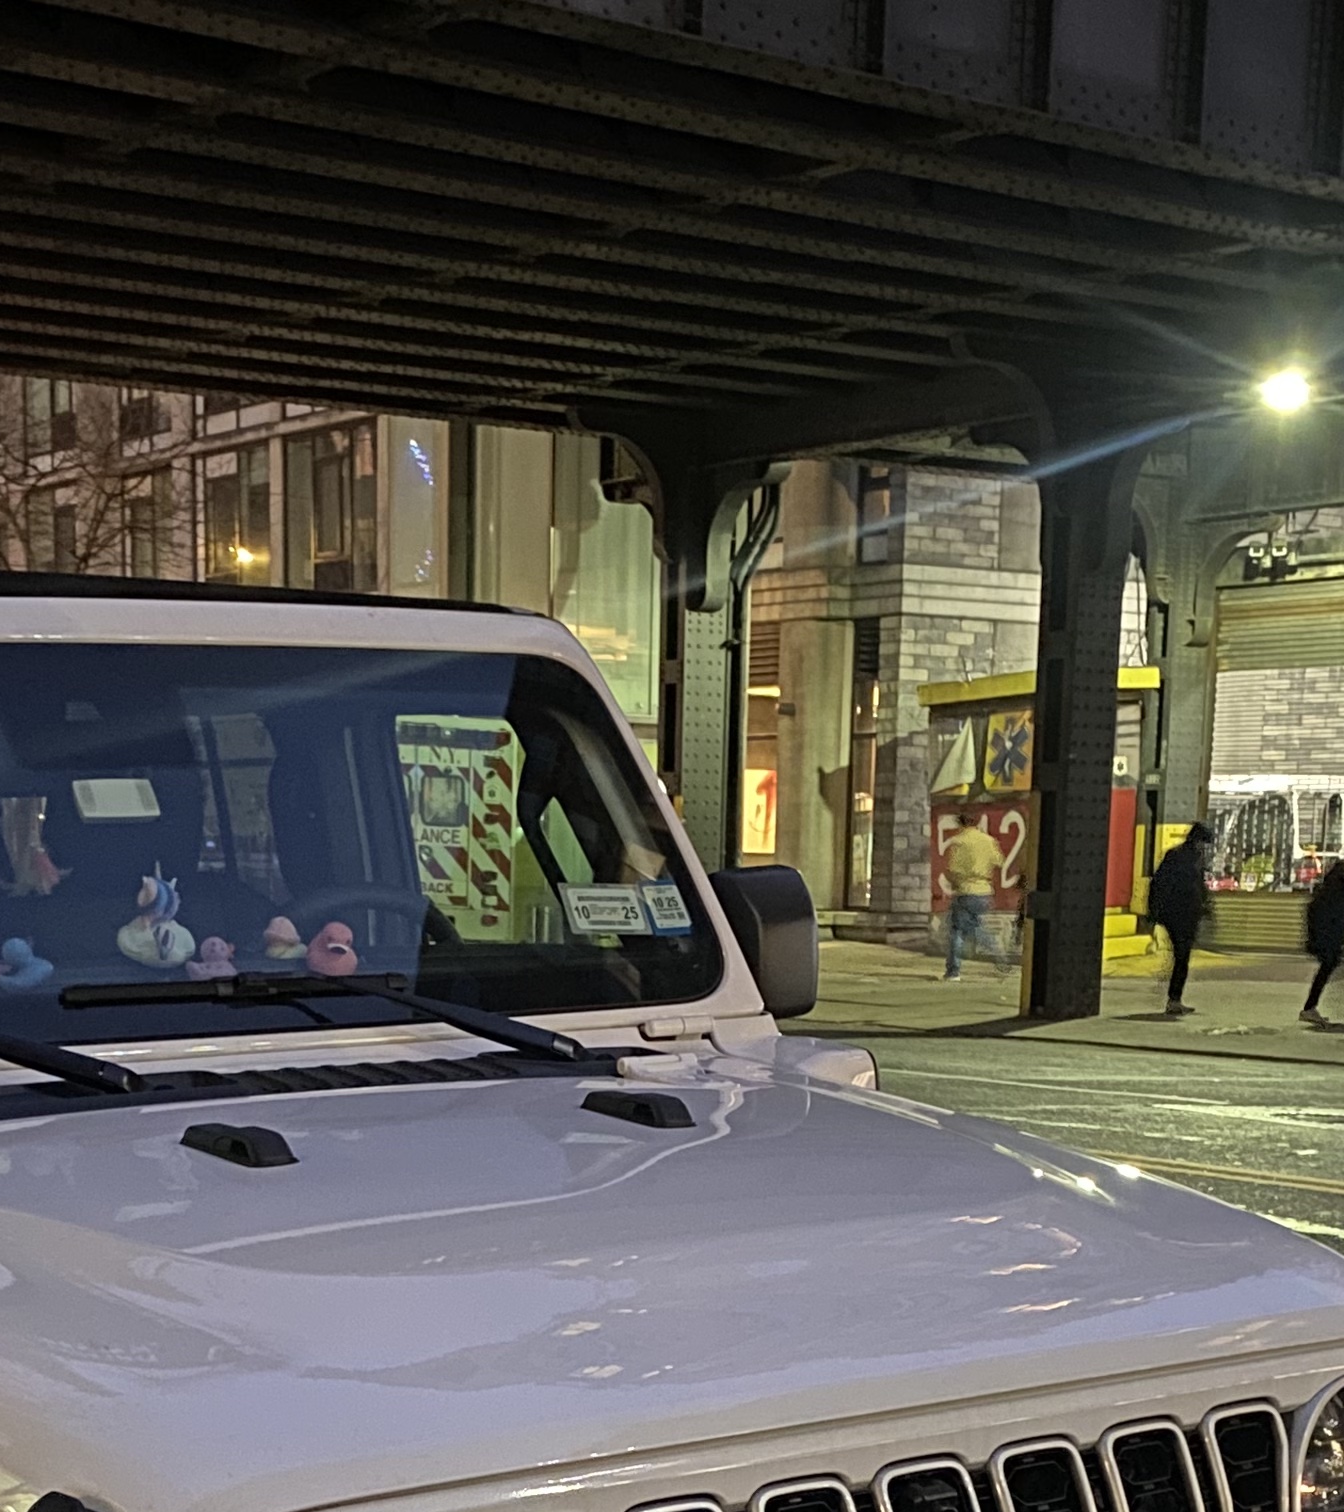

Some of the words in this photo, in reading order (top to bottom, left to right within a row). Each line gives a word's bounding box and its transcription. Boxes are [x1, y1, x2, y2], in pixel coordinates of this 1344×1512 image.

[414, 828, 461, 844] ANCE
[937, 810, 1027, 895] 52
[653, 897, 664, 908] 10
[667, 896, 679, 908] 25
[575, 905, 590, 920] 10
[622, 905, 639, 920] 25
